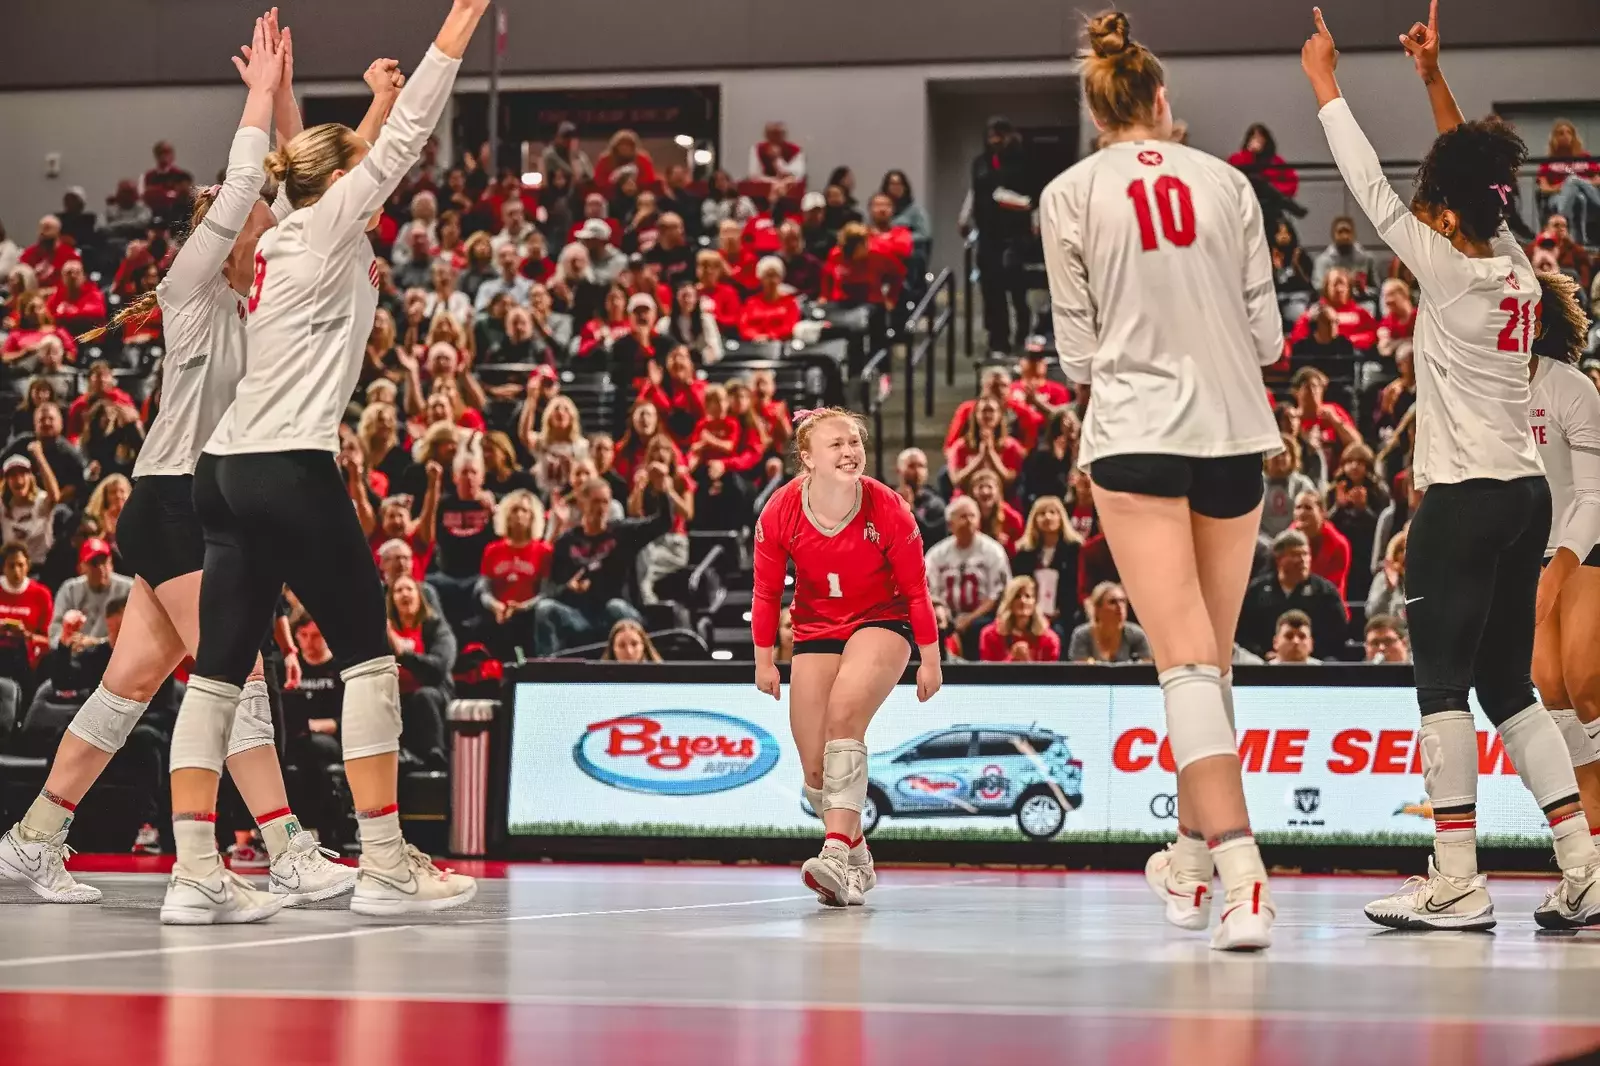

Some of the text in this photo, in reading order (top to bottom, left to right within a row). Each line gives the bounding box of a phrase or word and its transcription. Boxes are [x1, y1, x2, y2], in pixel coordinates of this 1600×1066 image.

[1126, 174, 1197, 251] 10
[827, 572, 843, 597] 1
[587, 716, 755, 771] Byers
[1326, 728, 1423, 775] SE
